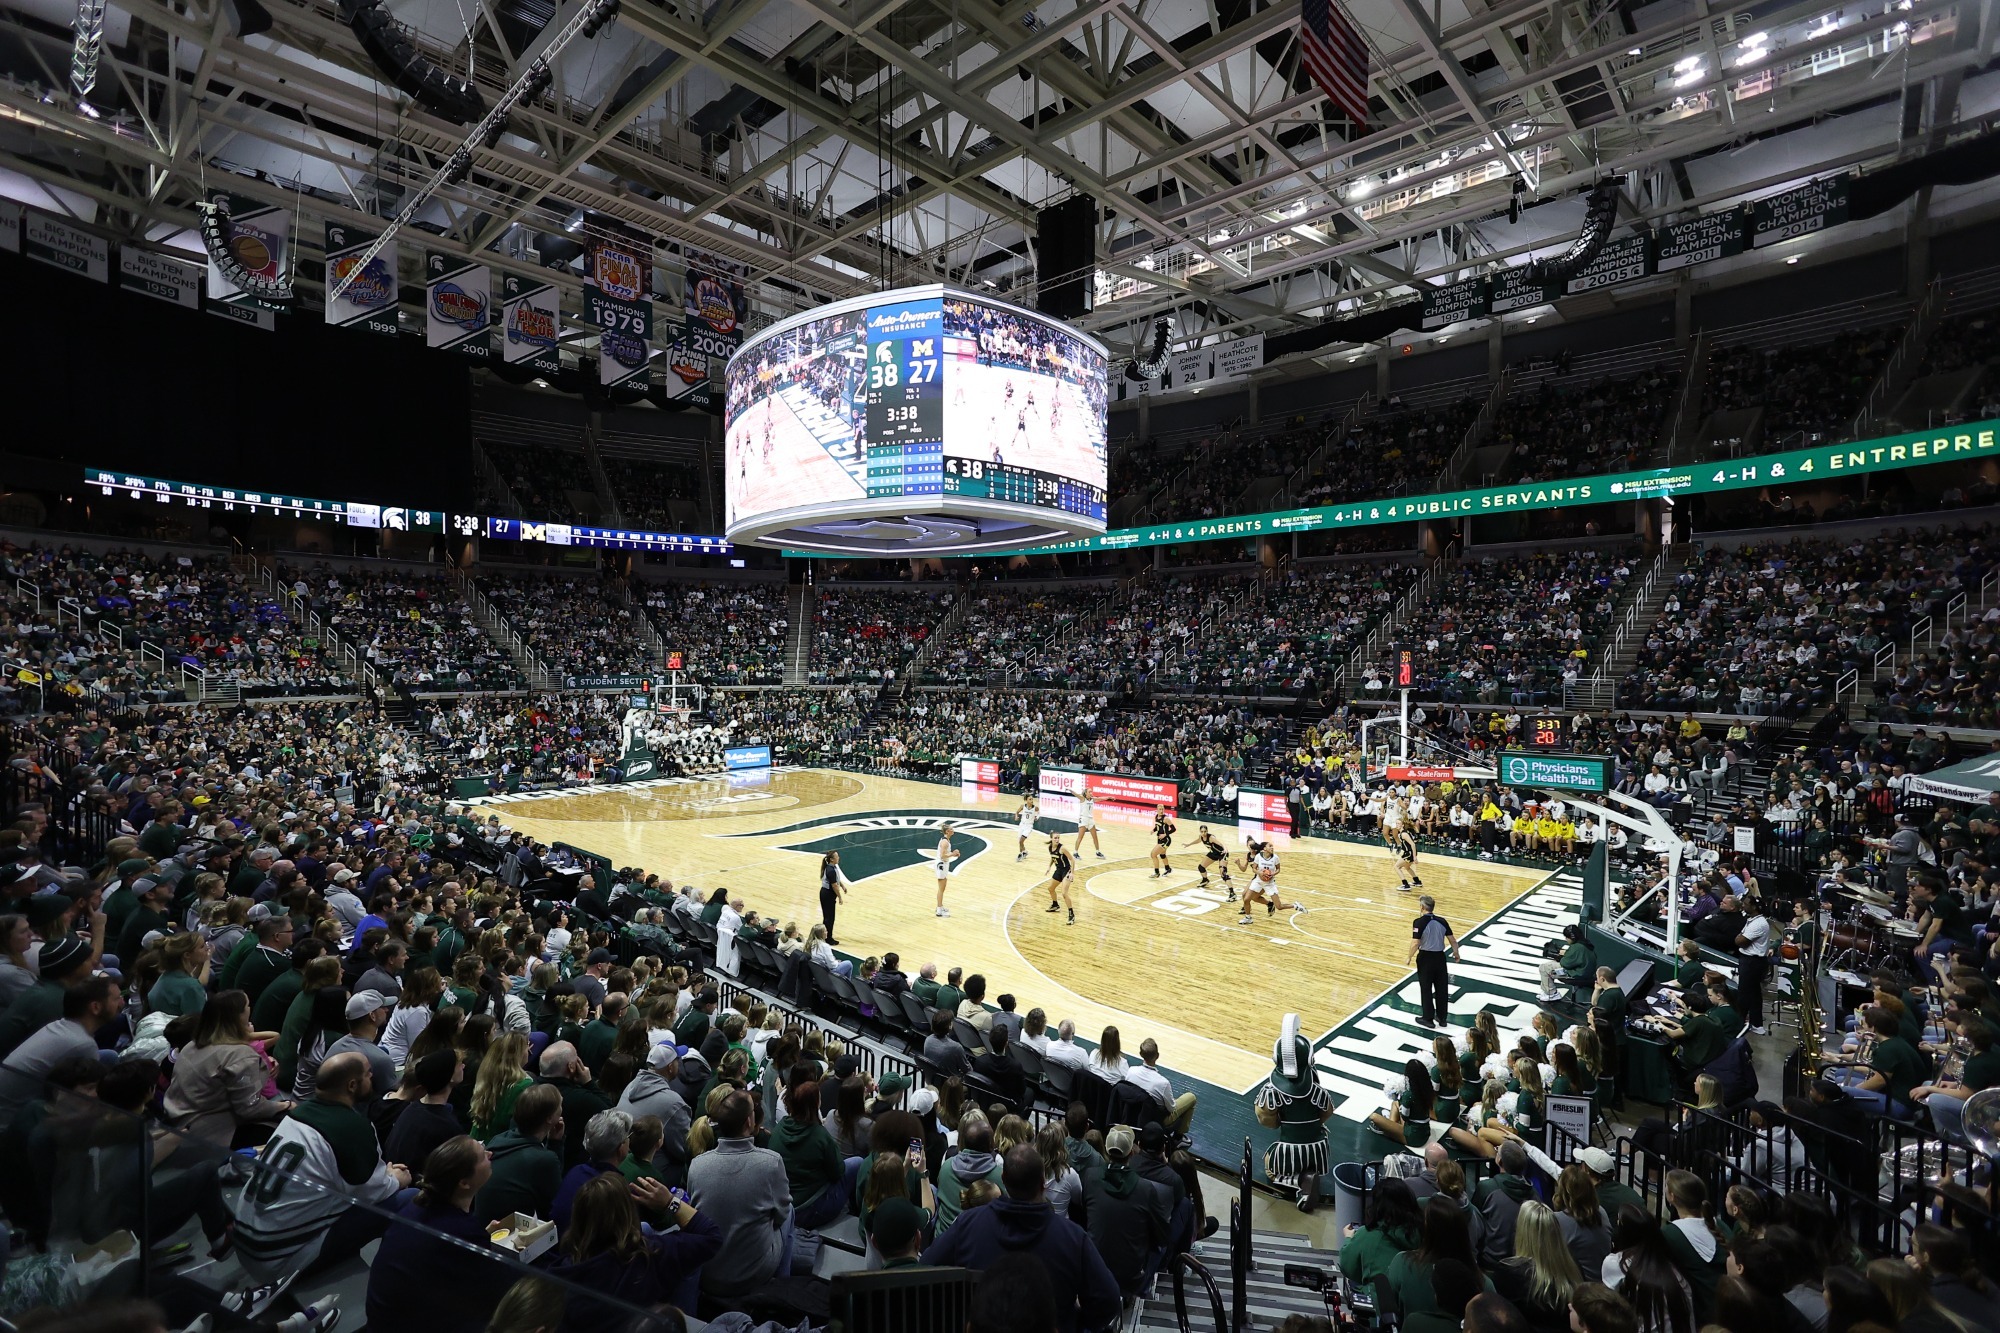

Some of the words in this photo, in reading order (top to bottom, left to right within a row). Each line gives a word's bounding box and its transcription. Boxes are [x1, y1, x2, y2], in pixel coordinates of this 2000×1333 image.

[1767, 179, 1836, 209] WOMEN'S
[1773, 203, 1797, 217] BIG
[1802, 192, 1829, 207] TEN
[1756, 196, 1847, 231] CHAMPIONS
[1670, 212, 1733, 236] WOMEN'S
[1781, 218, 1818, 238] 2014
[44, 222, 65, 236] BIG
[69, 231, 91, 247] TEN
[234, 225, 267, 240] NCAA
[1676, 232, 1697, 245] BIG
[1702, 224, 1726, 238] TEN
[29, 228, 106, 262] CHAMPIONS
[1661, 229, 1742, 258] CHAMPIONS
[53, 251, 84, 268] 1967
[605, 250, 630, 264] NCAA
[1684, 248, 1714, 265] 2011
[138, 255, 157, 268] BIG
[161, 263, 183, 276] TEN
[600, 255, 637, 278] FINAL
[123, 261, 196, 290] CHAMPIONS
[601, 269, 637, 290] FOUR
[1588, 270, 1628, 288] 2005
[145, 281, 176, 297] 1959
[606, 283, 632, 296] 1979
[1431, 281, 1477, 298] WOMEN'S
[1424, 295, 1484, 316] CHAMPIONS
[1435, 296, 1452, 306] BIG
[1453, 290, 1473, 302] TEN
[1510, 292, 1541, 307] 2005
[228, 306, 254, 320] 1957
[591, 297, 645, 318] CHAMPIONS
[518, 309, 553, 327] FINAL
[593, 307, 645, 334] 1979
[868, 310, 941, 328] Auto-Owners
[1441, 311, 1466, 323] 1997
[368, 320, 397, 333] 1999
[522, 322, 555, 338] FOUR
[882, 321, 926, 333] INSURANCE
[692, 326, 737, 345] CHAMPIONS
[462, 344, 489, 357] 2001
[692, 335, 739, 358] 2000
[912, 339, 934, 357] M
[1219, 345, 1259, 360] HEATHCOTE
[1232, 341, 1245, 349] JUD
[534, 359, 559, 371] 2005
[1178, 354, 1202, 365] JOHNNY
[1180, 363, 1200, 371] GREEN
[1221, 359, 1236, 367] HEAD
[1237, 355, 1256, 364] COACH
[871, 363, 898, 388] 38
[909, 359, 937, 384] 27
[1184, 372, 1197, 383] 24
[627, 380, 649, 391] 2009
[1138, 383, 1149, 392] 32
[691, 394, 709, 404] 2010
[887, 406, 918, 421] 3:38
[1712, 466, 1757, 483] 4-H
[1771, 463, 1785, 477] &
[1799, 459, 1814, 473] 4
[1830, 430, 1995, 470] ENTREPRE
[962, 460, 982, 479] 38
[1038, 479, 1058, 494] 3:38
[1624, 480, 1641, 488] MSU
[1643, 475, 1692, 486] EXTENSION
[155, 481, 170, 491] FT%
[182, 485, 196, 495] FTM
[202, 488, 214, 497] FTA
[222, 491, 235, 499] REB
[271, 497, 283, 505] AST
[314, 501, 322, 509] TO
[332, 504, 343, 512] STL
[1092, 487, 1101, 503] 27
[102, 487, 112, 495] 50
[130, 490, 140, 499] 40
[156, 493, 170, 503] 100
[225, 502, 233, 511] 14
[335, 514, 339, 522] 3
[349, 506, 366, 514] FOULS
[1334, 510, 1362, 522] 4-H
[1370, 508, 1379, 519] &
[1387, 506, 1396, 516] 4
[1405, 499, 1472, 515] PUBLIC
[1481, 485, 1592, 508] SERVANTS
[349, 515, 359, 524] TOL
[416, 511, 430, 525] 38
[454, 515, 479, 530] 3:38
[496, 520, 509, 532] 27
[522, 522, 546, 540] M
[1149, 531, 1170, 541] 4-H
[1175, 530, 1183, 539] &
[1188, 528, 1195, 537] 4
[1201, 520, 1262, 536] PARENTS
[668, 658, 680, 668] 20
[1537, 720, 1560, 729] 3:37
[1536, 731, 1554, 744] 20
[1532, 761, 1588, 774] Physicians
[1041, 774, 1075, 789] meijer
[1102, 779, 1127, 789] OFFICIAL
[1129, 782, 1152, 791] GROCER
[1532, 773, 1568, 783] Health
[1571, 775, 1595, 786] Plan
[1093, 786, 1121, 795] MICHIGAN
[1122, 789, 1140, 798] STATE
[1141, 791, 1173, 802] ATHLETICS
[1925, 784, 1979, 800] spartandawgs
[1553, 1104, 1583, 1113] #BRESLIN
